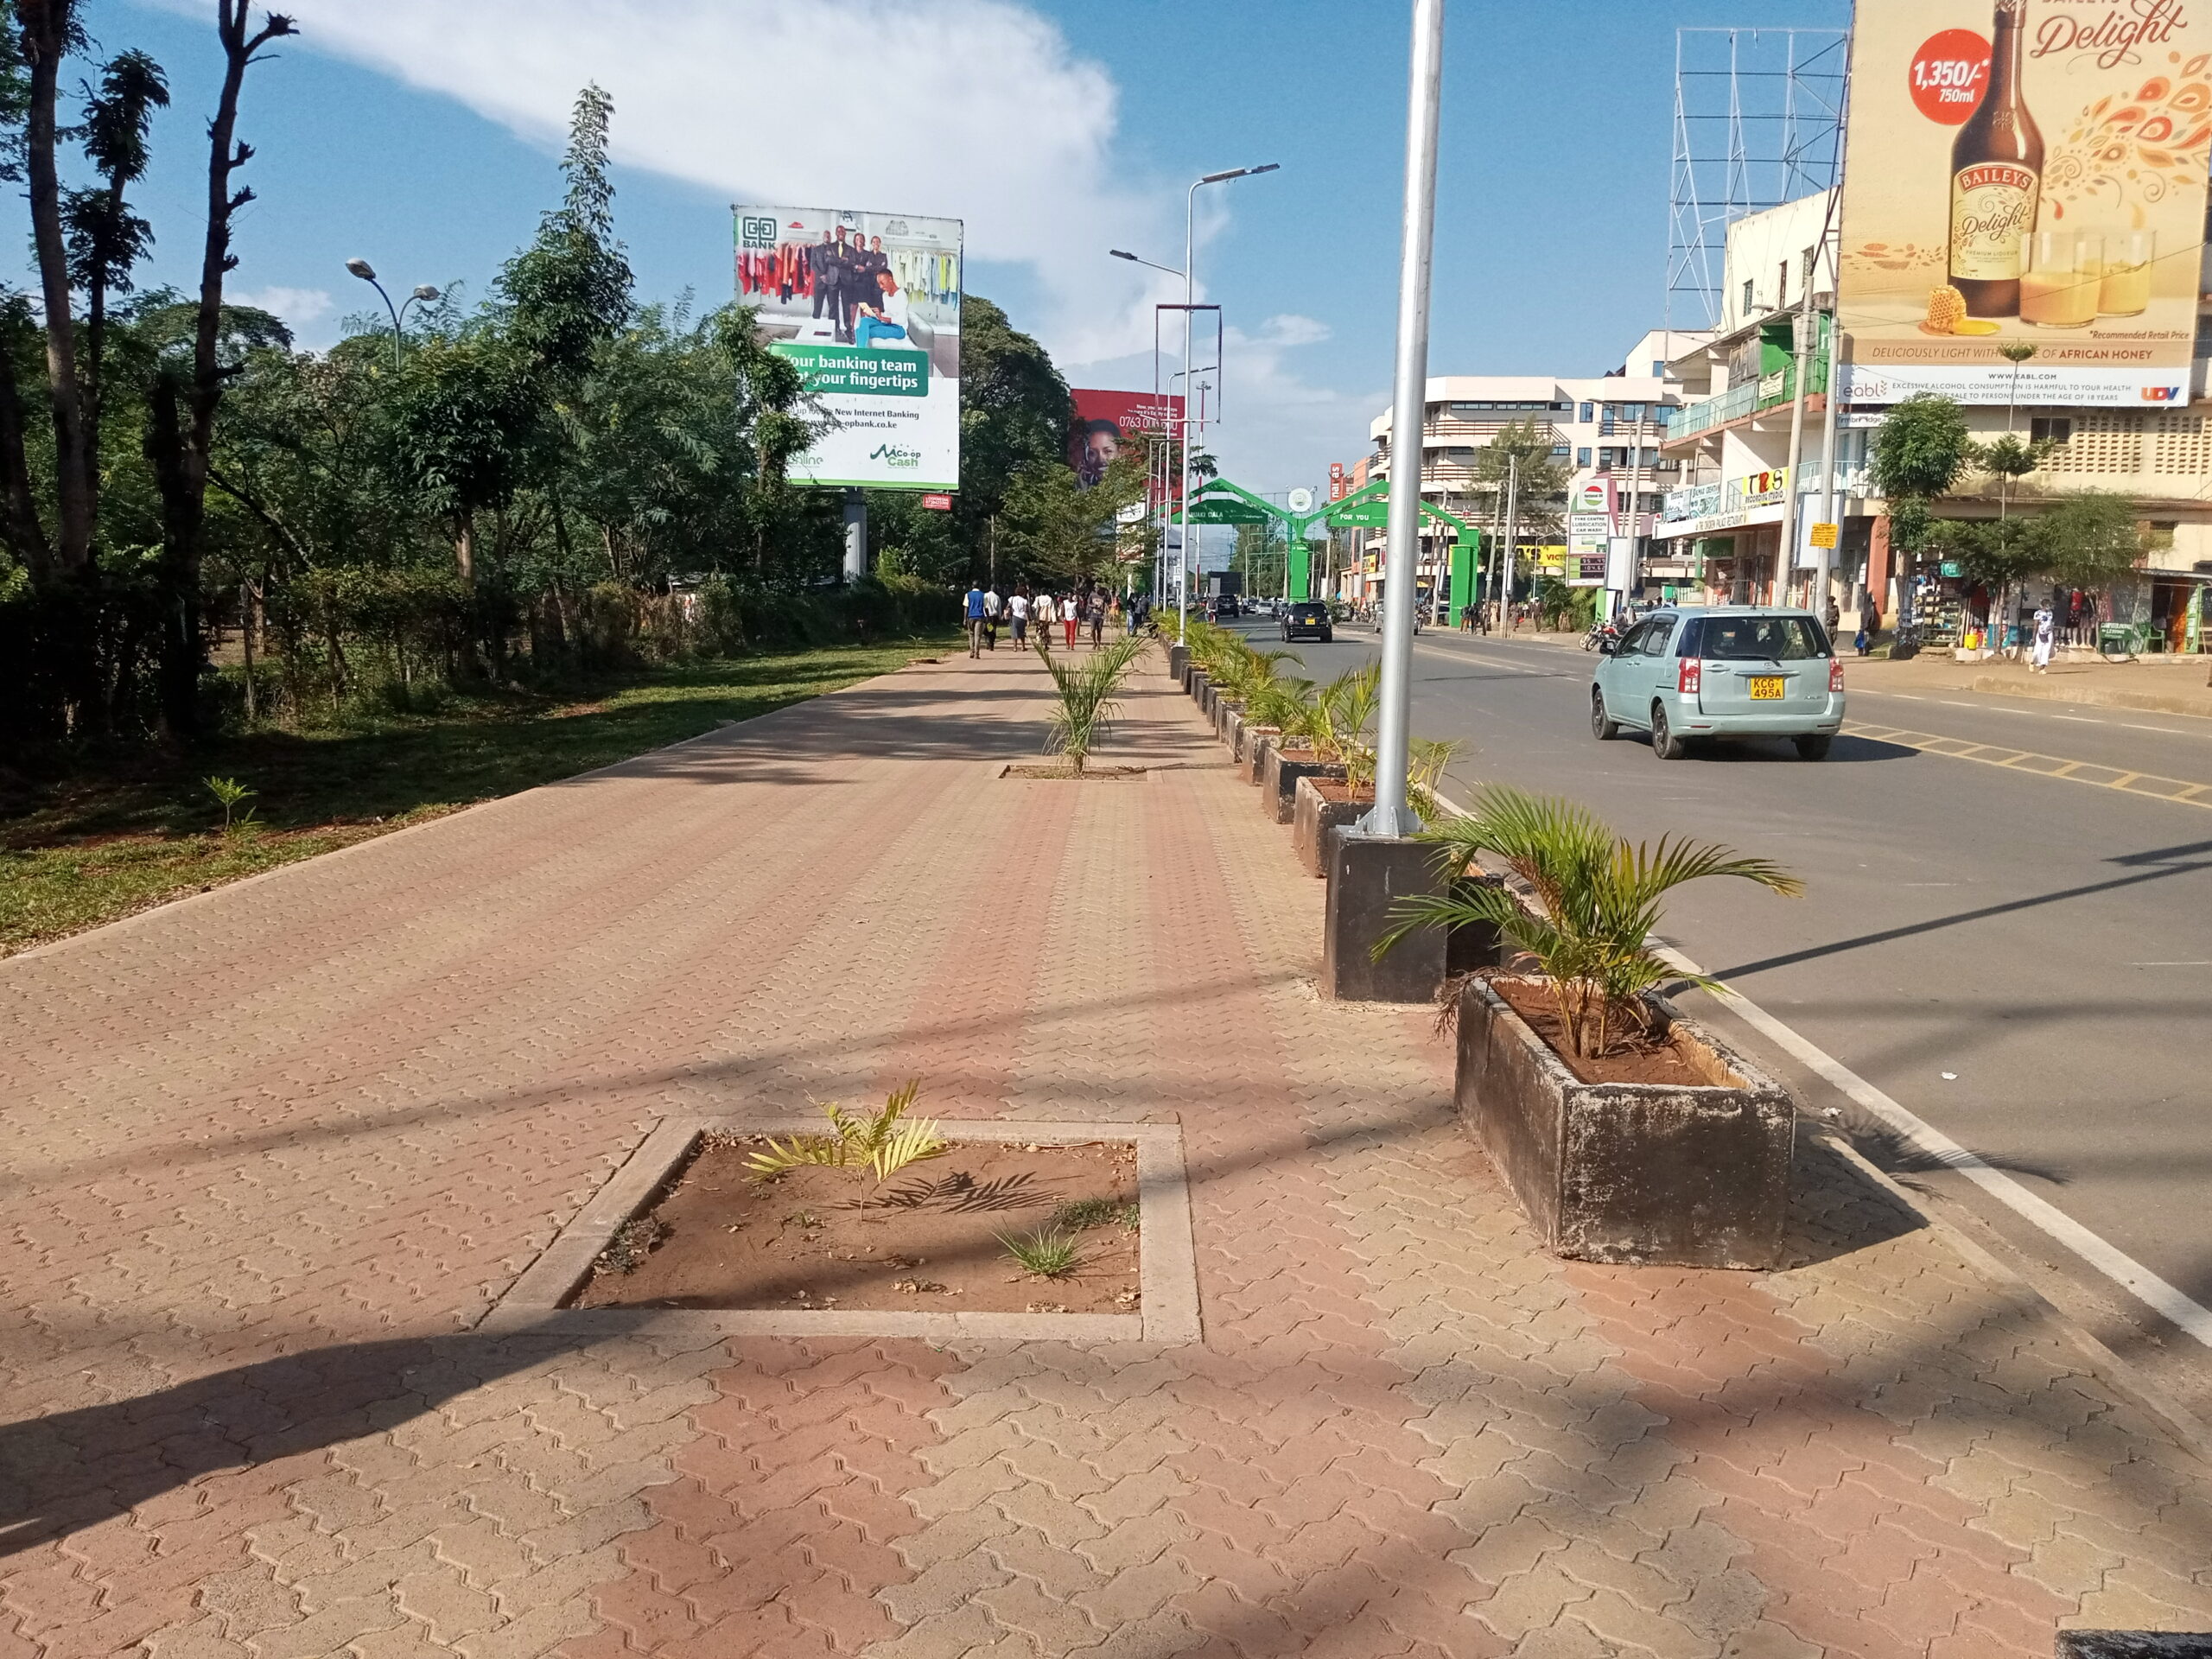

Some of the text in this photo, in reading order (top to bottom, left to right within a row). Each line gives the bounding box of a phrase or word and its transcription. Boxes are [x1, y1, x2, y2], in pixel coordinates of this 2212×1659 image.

[2031, 0, 2188, 74] Delight
[1938, 88, 1975, 103] 750ml
[1961, 168, 2029, 188] BAILEYS
[1960, 202, 2029, 241] Delight
[743, 240, 775, 250] BANK
[1872, 347, 1940, 358] DELICIOUSLY
[1942, 348, 1971, 358] LIGHT
[1974, 348, 1999, 358] WITH
[2043, 349, 2058, 359] OF
[2059, 350, 2108, 359] AFRICAN
[2112, 351, 2152, 359] HONEY
[818, 354, 877, 373] banking
[881, 359, 917, 372] team
[849, 372, 918, 391] fingertips
[1843, 382, 1881, 397] eabl
[2141, 387, 2179, 401] UDV
[855, 409, 884, 417] Internet
[887, 410, 919, 420] Banking
[1120, 416, 1141, 428] 0763
[887, 456, 918, 467] Cash
[1753, 678, 1775, 689] KCG
[1754, 689, 1782, 698] 495A
